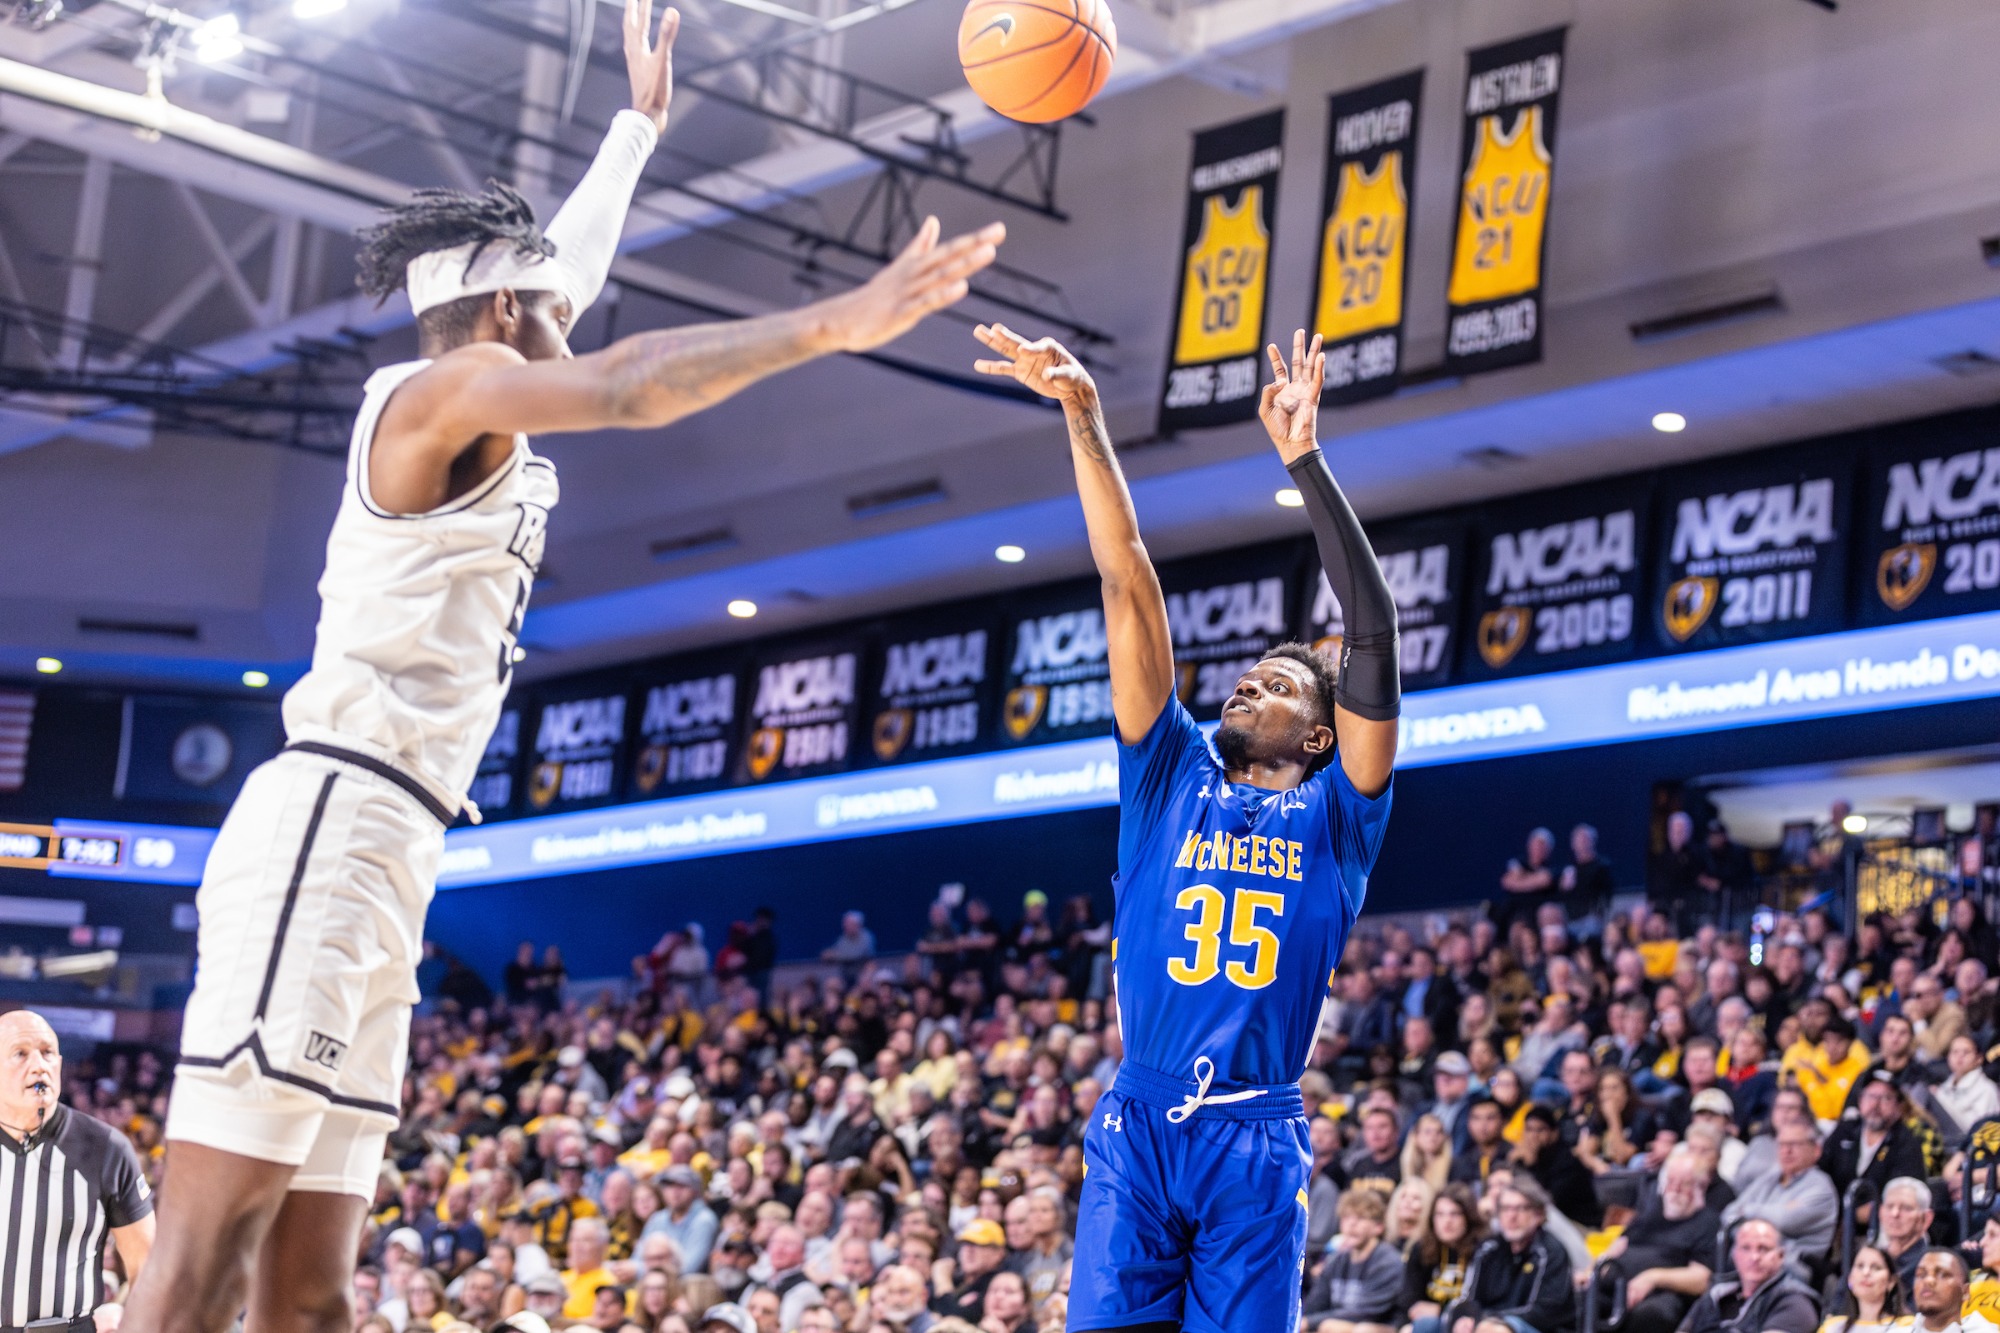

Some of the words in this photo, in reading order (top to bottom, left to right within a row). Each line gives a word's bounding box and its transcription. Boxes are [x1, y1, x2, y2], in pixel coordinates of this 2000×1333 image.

[1472, 223, 1512, 270] 21
[1202, 292, 1241, 334] 00
[1339, 264, 1382, 310] 20
[1670, 477, 1833, 563] NCAA
[1311, 544, 1450, 625] NAA
[1486, 509, 1635, 596] NCAA
[1167, 576, 1285, 646] NCAA
[1534, 593, 1634, 653] 2009
[1720, 569, 1812, 628] 2011
[752, 653, 856, 718] NCAA
[881, 629, 987, 697] NCAA
[535, 695, 627, 752] NCAA
[641, 673, 736, 736] NCAA
[1411, 702, 1547, 748] HONDA
[1628, 669, 1769, 723] Richmond
[1769, 665, 1841, 704] Area
[1844, 648, 1949, 697] Honda
[994, 761, 1096, 804] Richmond
[1167, 884, 1285, 990] 35
